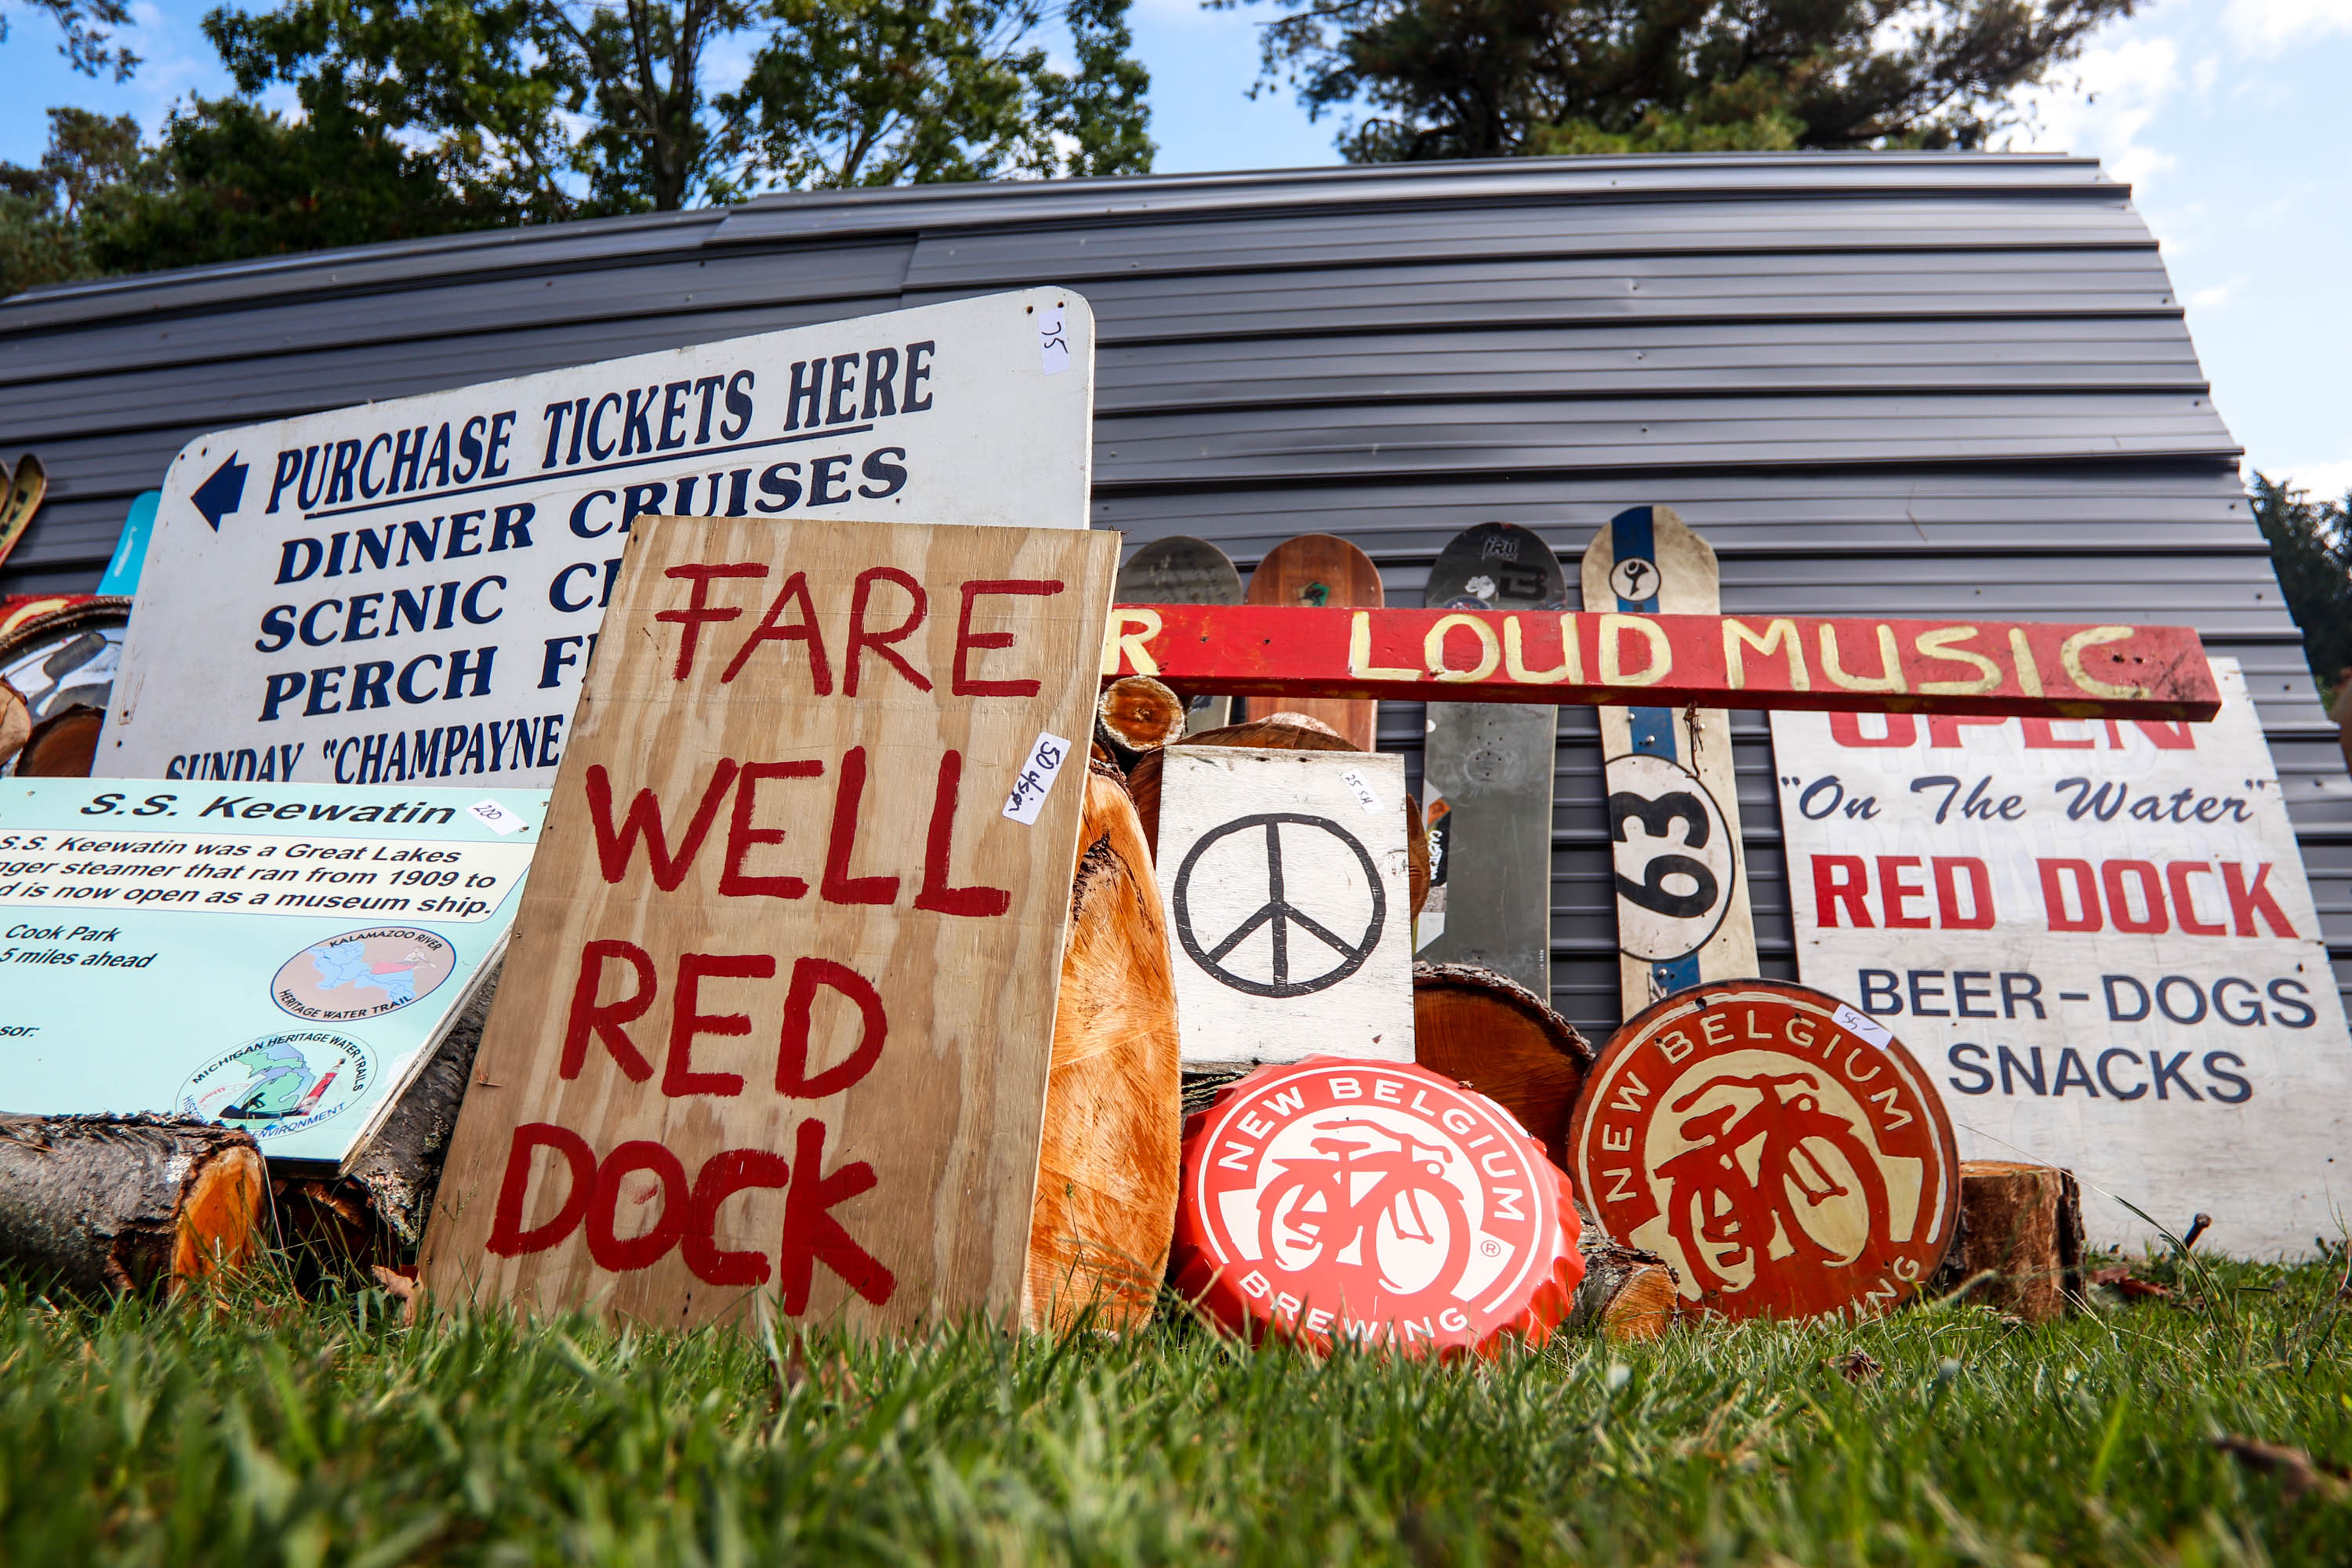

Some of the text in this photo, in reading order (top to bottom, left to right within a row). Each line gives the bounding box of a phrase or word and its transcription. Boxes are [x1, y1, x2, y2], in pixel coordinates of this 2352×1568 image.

[266, 340, 935, 514] PURCHASE TICKETS HERE
[274, 446, 908, 585] DINNER CRUISES
[256, 575, 507, 653] SCENIC
[655, 563, 1065, 697] FARE
[259, 645, 498, 722] PERCH
[1348, 611, 1673, 687] LOUD
[1722, 617, 2153, 699] MUSIC
[1035, 741, 1061, 770] 50
[80, 793, 457, 825] S.S. Keewatin
[586, 745, 1011, 918] WELL
[1910, 775, 2027, 826] The
[0, 836, 462, 864] S.S. Keewatin was a Great Lakes
[60, 860, 183, 877] steamer
[183, 862, 247, 880] that
[247, 867, 299, 882] ran
[304, 866, 378, 884] from
[388, 869, 460, 887] 1909
[464, 872, 497, 889] to
[5, 924, 122, 942] Cook Park
[19, 881, 50, 898] is
[53, 886, 122, 899] now
[122, 887, 201, 906] open
[204, 891, 244, 904] as
[247, 892, 270, 906] a
[274, 892, 411, 911] museum
[416, 895, 492, 918] ship.
[1811, 855, 2299, 939] RED DOCK
[14, 948, 80, 965] miles
[80, 950, 159, 968] ahead
[329, 930, 443, 952] KALAMAZOO RIVER
[278, 988, 412, 1020] HERITAGE WATER TRAIL
[559, 938, 889, 1100] RED
[191, 1033, 368, 1093] MICHIGAN HERITAGE WATER TRAILS
[1947, 1042, 2254, 1104] SNACKS
[1602, 1009, 1914, 1204] NEW BELGIUM
[1218, 1077, 1526, 1222] NEW BELGIUM
[485, 1117, 898, 1318] DOCK
[1239, 1269, 1468, 1345] BREWING
